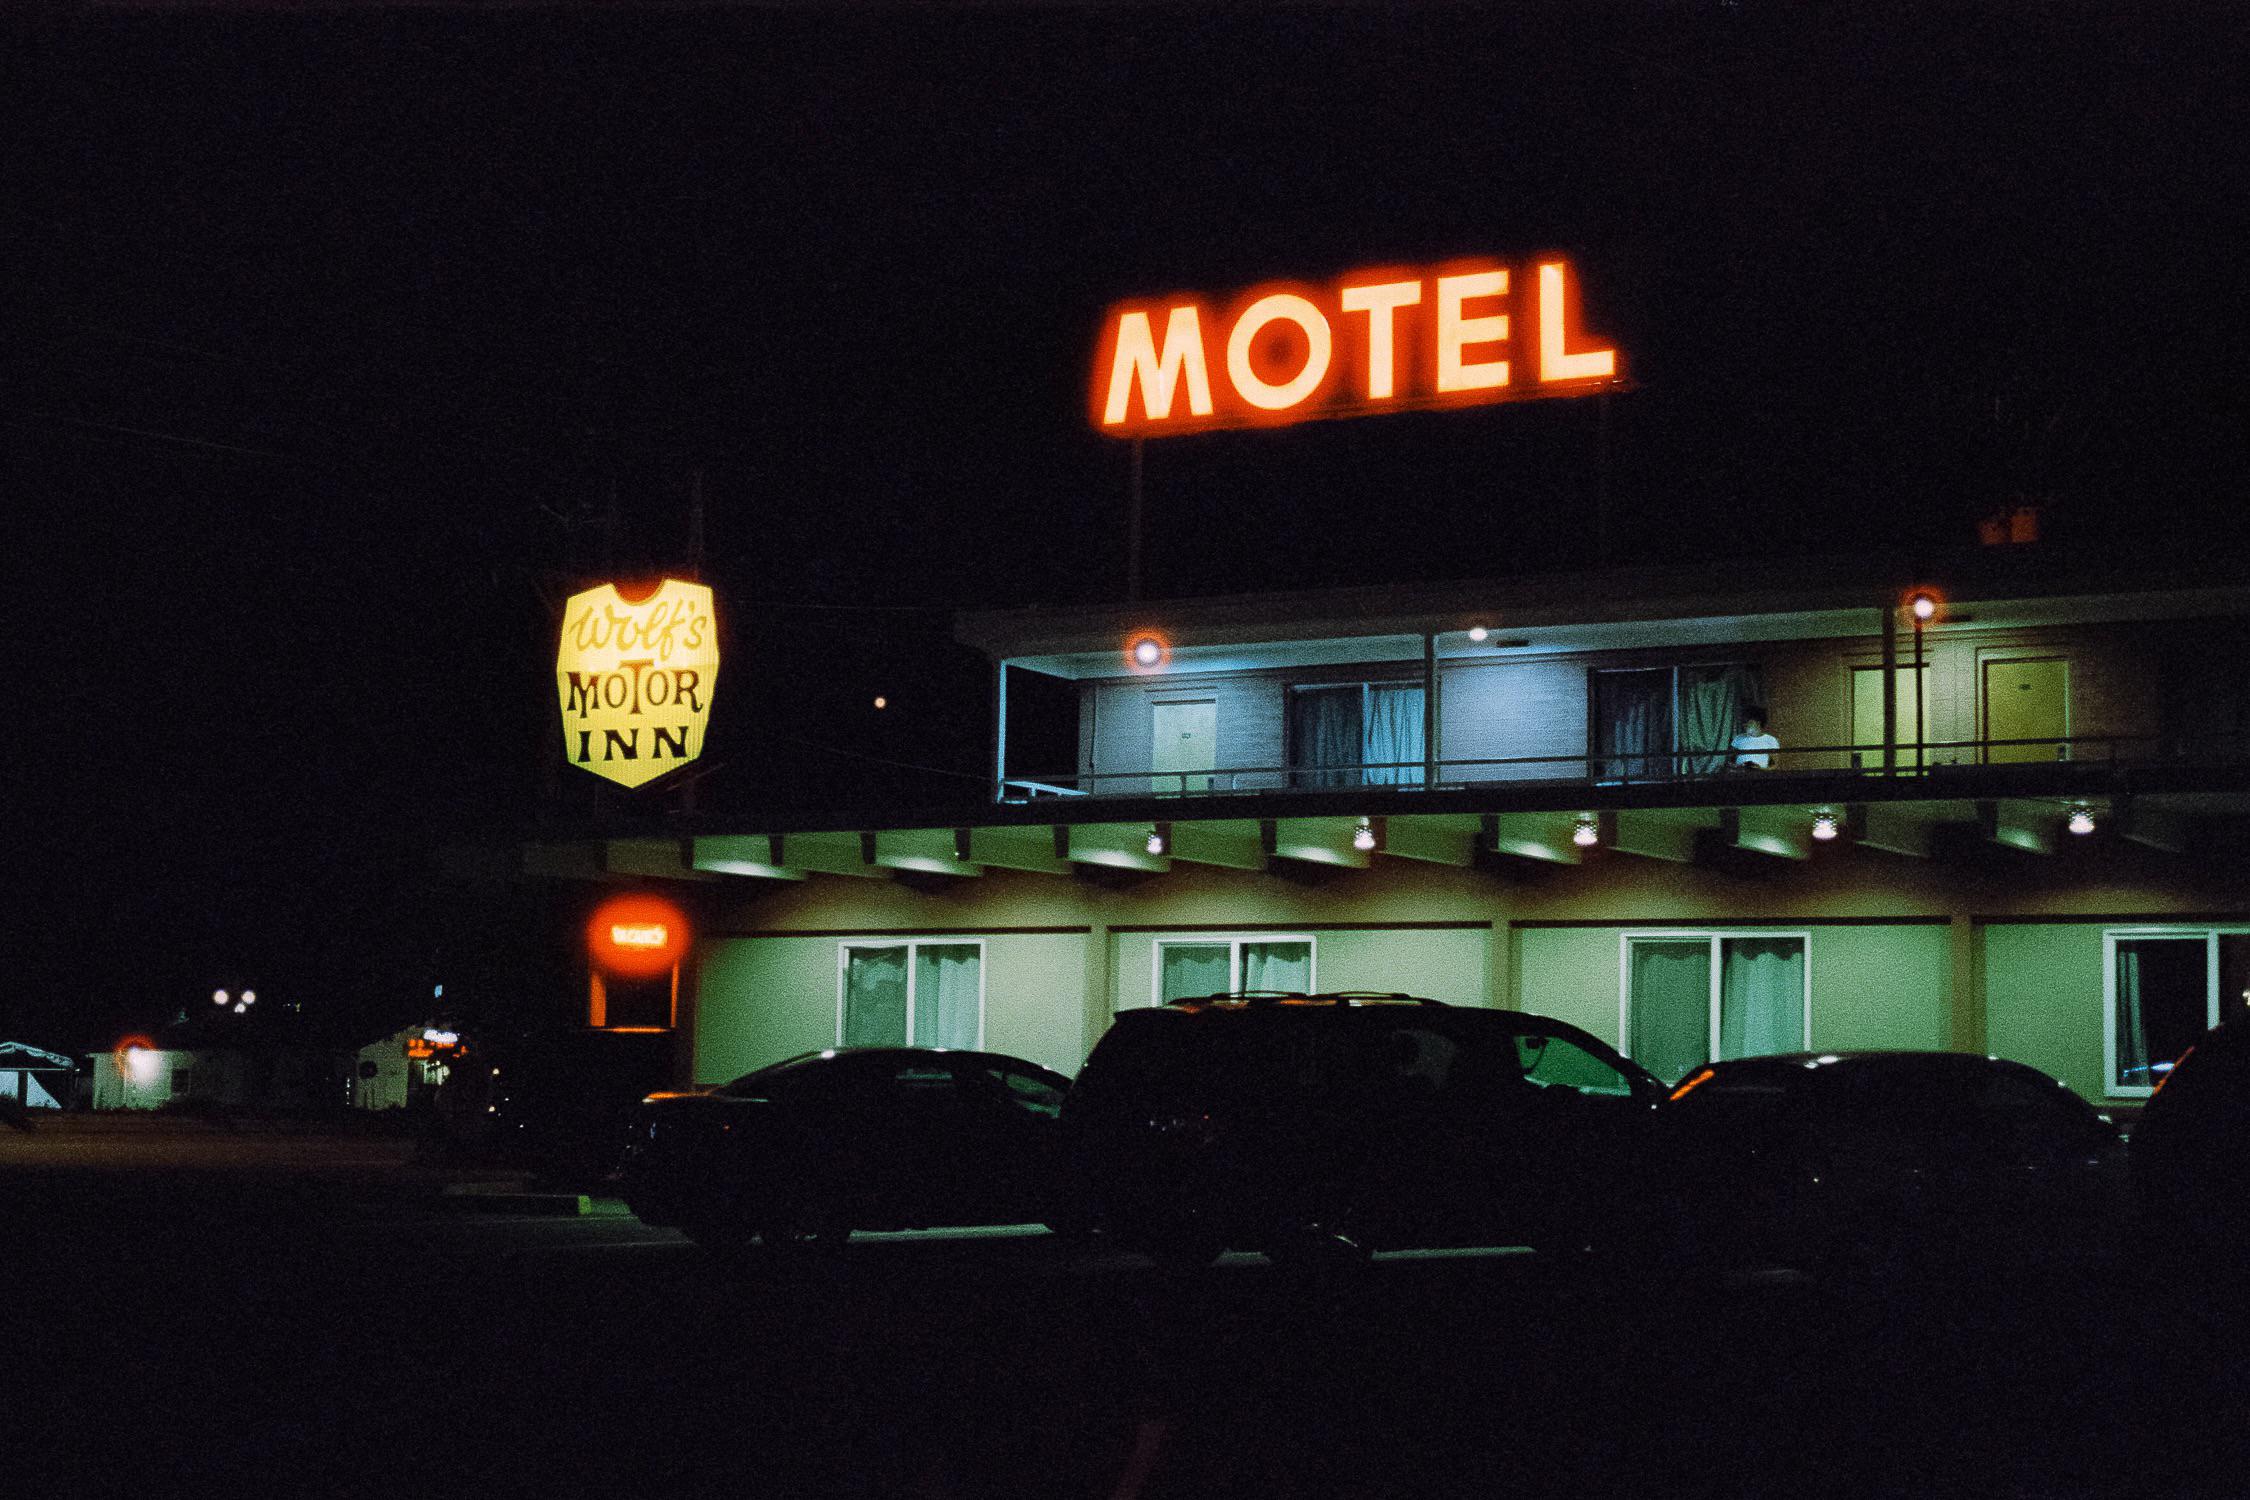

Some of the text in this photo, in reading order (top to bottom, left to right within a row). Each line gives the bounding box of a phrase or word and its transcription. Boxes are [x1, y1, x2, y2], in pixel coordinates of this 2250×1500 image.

[1103, 263, 1615, 425] MOTEL
[569, 599, 707, 661] Wolf's
[567, 658, 704, 719] MOTOR
[577, 726, 689, 763] INN
